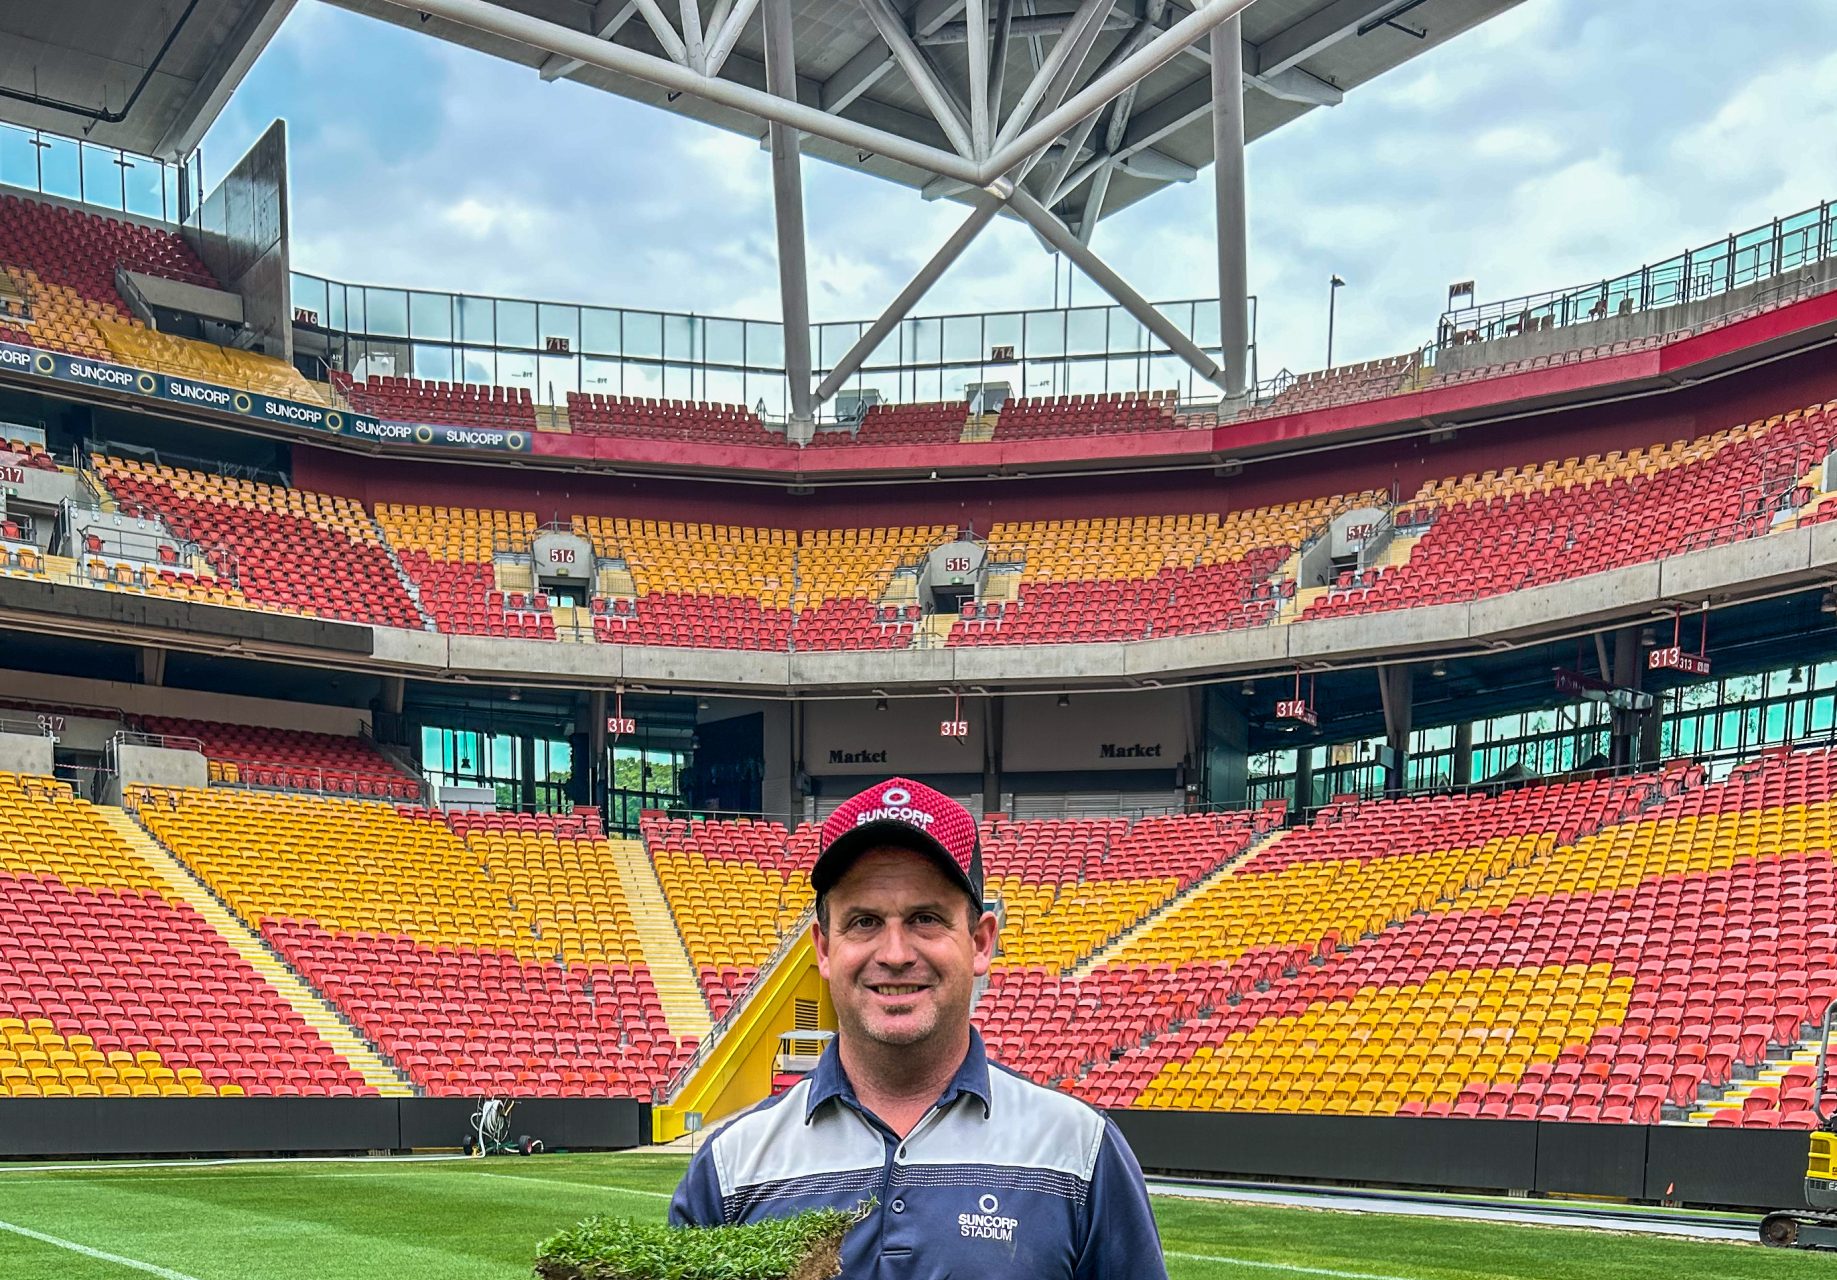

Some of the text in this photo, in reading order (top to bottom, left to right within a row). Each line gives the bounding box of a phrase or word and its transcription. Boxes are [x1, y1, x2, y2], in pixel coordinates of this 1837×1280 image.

[296, 310, 317, 324] 716
[547, 338, 568, 351] 715
[70, 363, 133, 386] SUNCORP
[170, 382, 230, 405] SUNCORP
[265, 401, 322, 423] SUNCORP
[355, 420, 411, 438] SUNCORP
[446, 430, 503, 446] SUNCORP
[1348, 525, 1371, 540] 514
[551, 550, 574, 563] 516
[947, 558, 969, 571] 515
[1650, 647, 1679, 668] 313
[1680, 658, 1692, 670] 313
[1277, 700, 1304, 717] 314
[37, 714, 64, 730] 317
[609, 718, 634, 733] 316
[941, 721, 967, 736] 315
[829, 749, 888, 763] Market
[1099, 743, 1162, 758] Market
[856, 806, 935, 827] SUNCORP
[958, 1213, 1018, 1230] SUNCORP
[960, 1224, 1012, 1242] STADIUM
